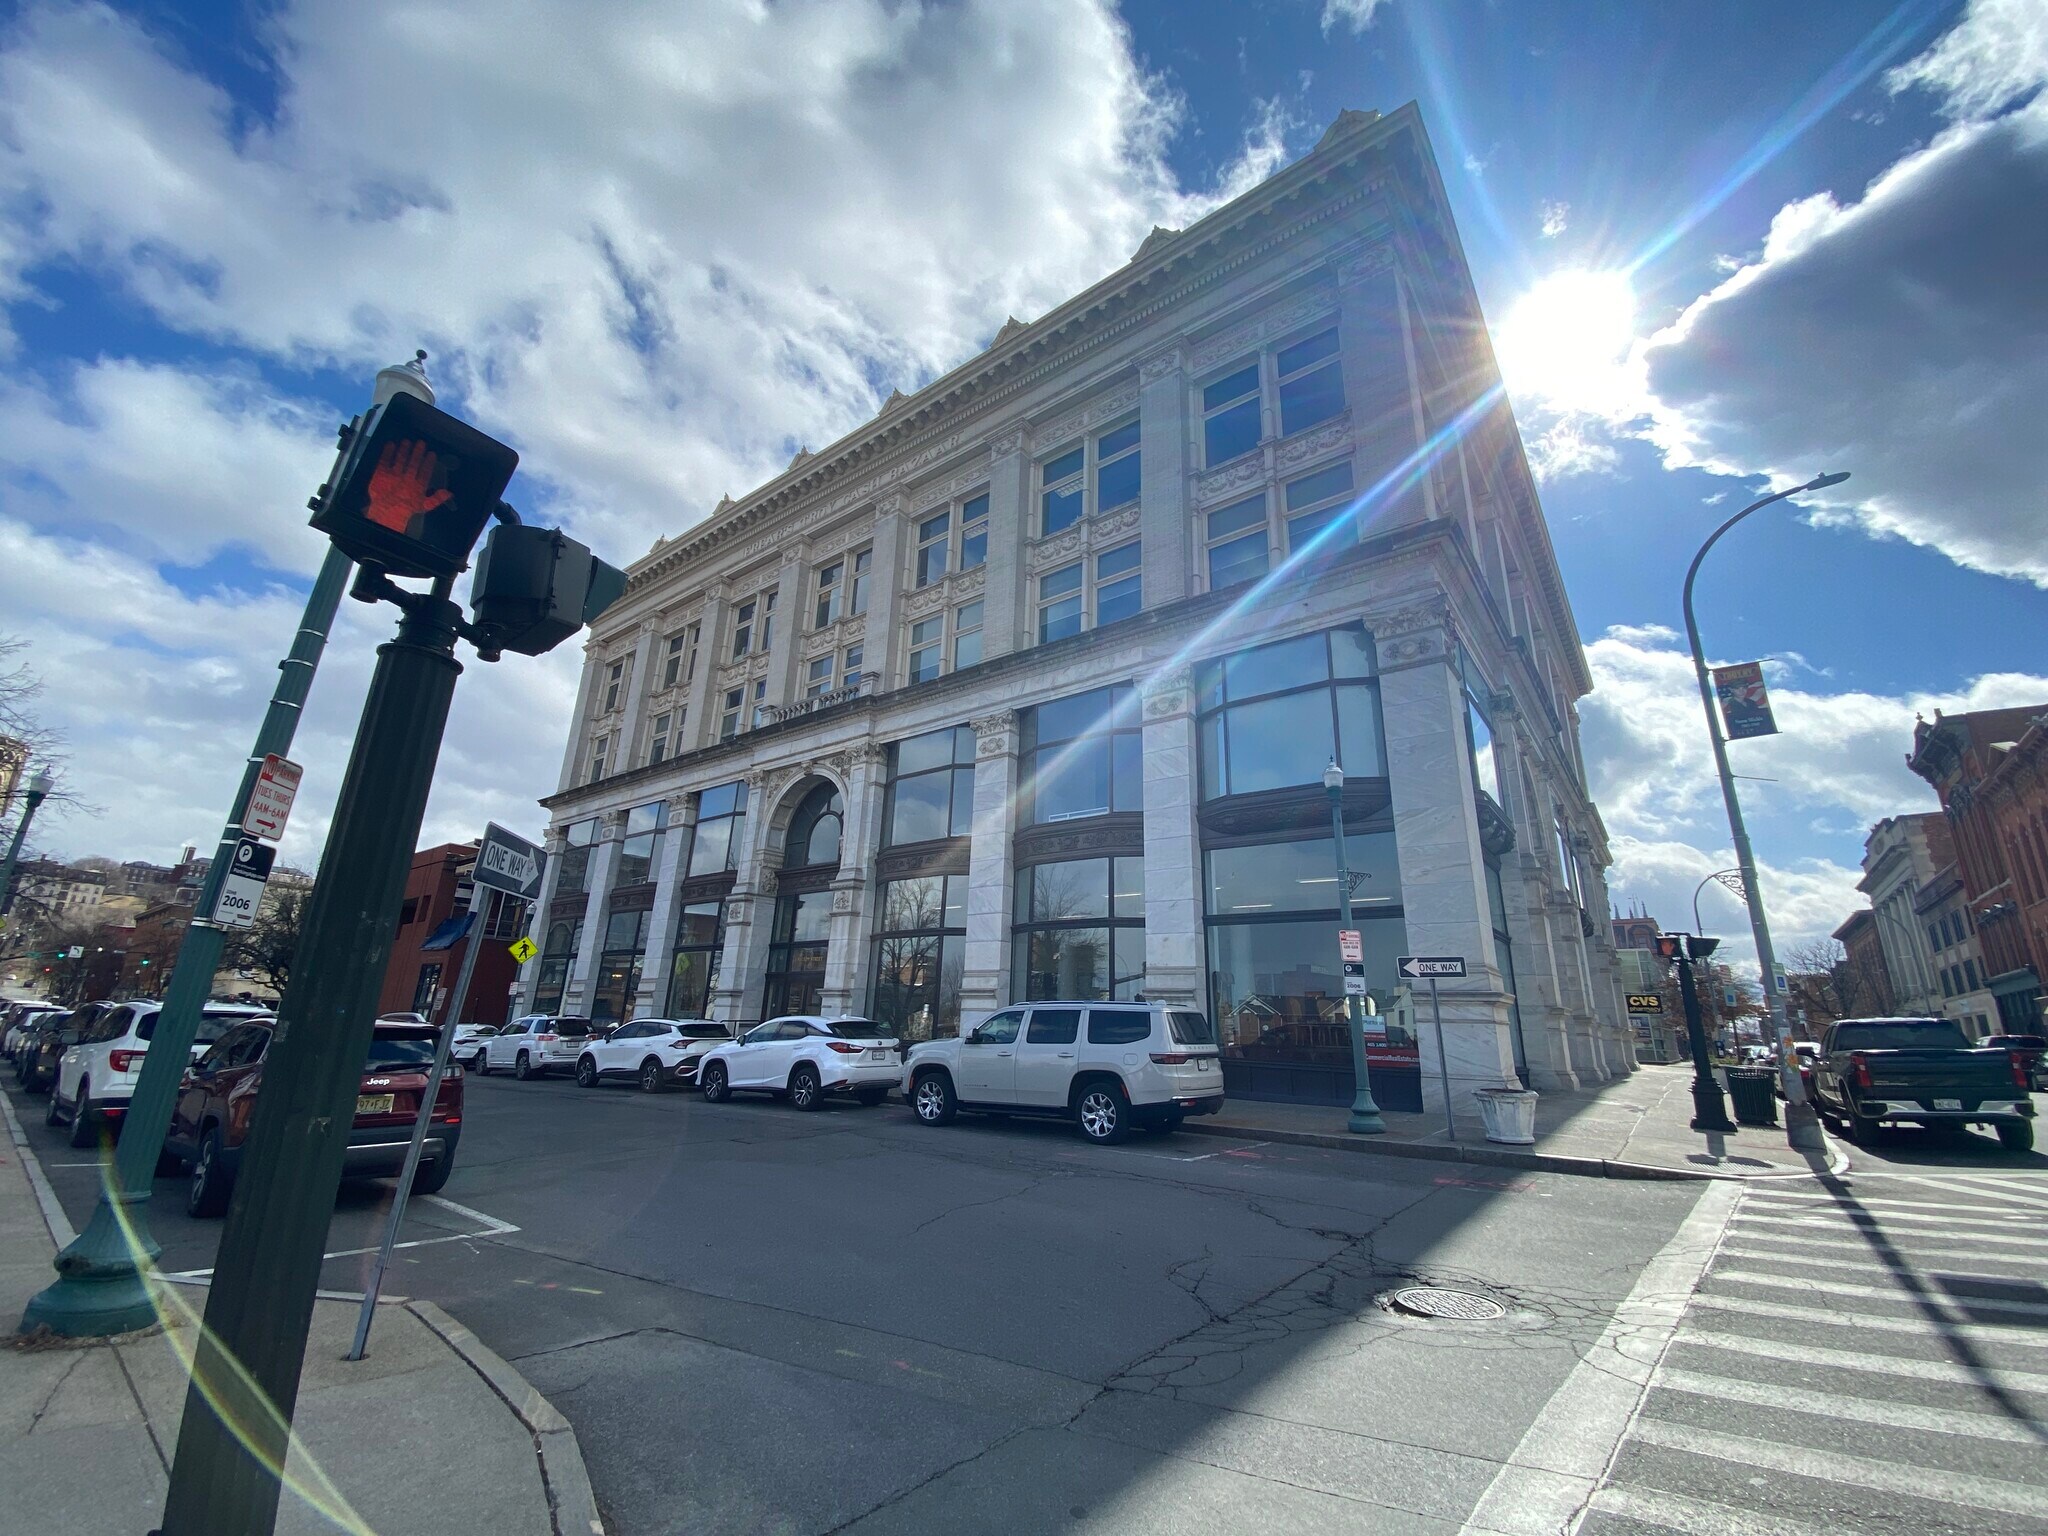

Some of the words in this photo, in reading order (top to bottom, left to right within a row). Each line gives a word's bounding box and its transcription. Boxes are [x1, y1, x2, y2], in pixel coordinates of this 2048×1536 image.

[263, 759, 277, 776] NO
[275, 766, 300, 784] PARKING
[254, 801, 287, 820] 4AM-6AM
[486, 844, 508, 871] ONE
[508, 853, 527, 878] WAY
[222, 895, 251, 910] 2006
[1419, 963, 1438, 972] ONE
[1440, 963, 1459, 972] WAY
[1629, 996, 1659, 1006] CVS
[366, 1077, 390, 1086] Jeep
